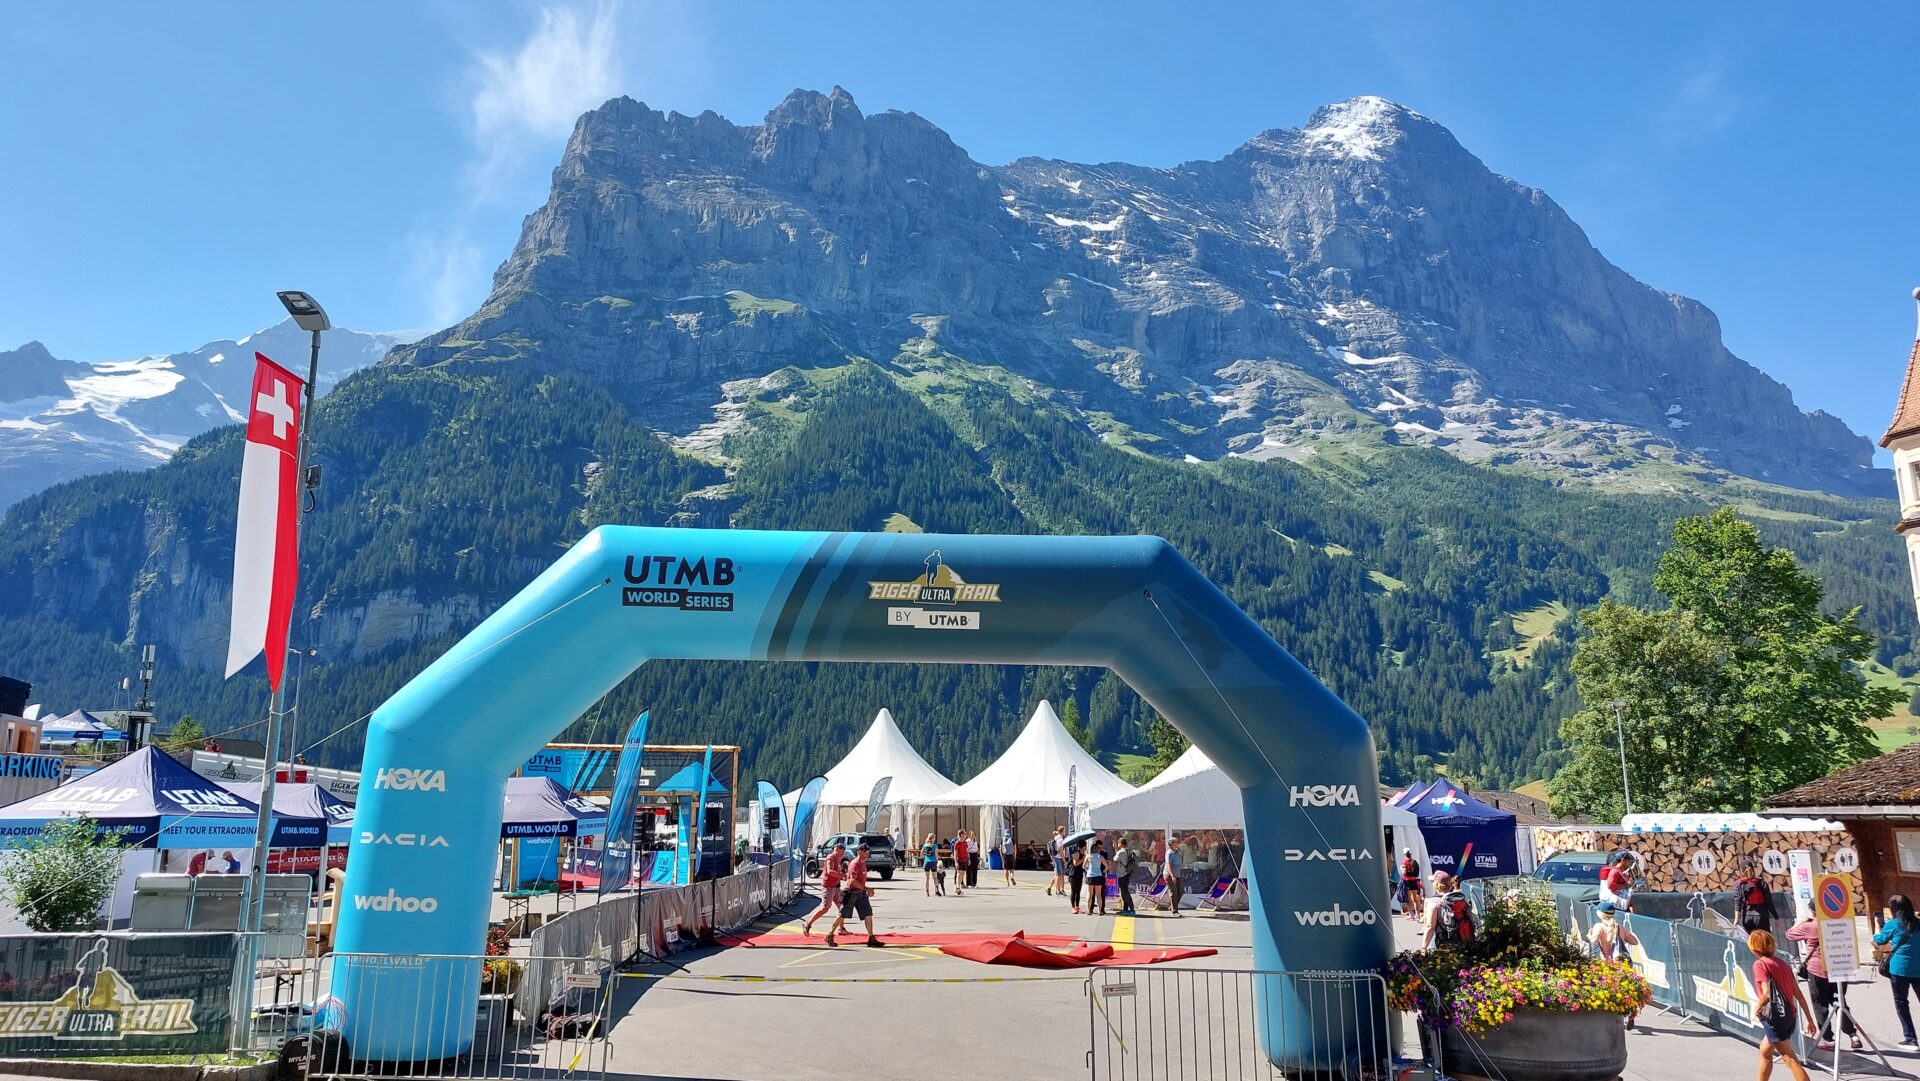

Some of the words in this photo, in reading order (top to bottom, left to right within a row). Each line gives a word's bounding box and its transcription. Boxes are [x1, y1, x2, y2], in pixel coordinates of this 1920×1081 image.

[624, 555, 735, 586] UTMB
[627, 591, 680, 604] WORLD
[685, 595, 730, 608] SERIES
[869, 583, 921, 599] EIGER
[921, 588, 951, 601] ULTRA
[954, 583, 999, 600] TRAIL
[895, 611, 912, 622] BY
[929, 614, 969, 626] UTMB
[528, 754, 562, 765] UTMB
[374, 768, 447, 792] HOKA
[46, 787, 138, 802] UTMB
[161, 789, 239, 805] UTMB
[1289, 784, 1361, 807] HOKA
[1431, 797, 1466, 805] HOKA
[164, 826, 183, 834] MEET
[185, 826, 206, 834] YOUR
[208, 826, 258, 834] EXTRAORDINA
[281, 827, 320, 835] UTMB.WORLD
[507, 825, 569, 834] UTMB.WORLD
[360, 831, 449, 847] DACIA
[1284, 848, 1373, 861] DACIA
[354, 888, 438, 913] wahoo
[1294, 903, 1376, 926] wahoo
[1697, 981, 1728, 1011] EIGER
[1728, 998, 1750, 1020] ULTRA
[69, 1013, 114, 1032] ULTRA
[119, 1001, 192, 1030] TRAIL
[288, 1054, 316, 1064] MYLAS
